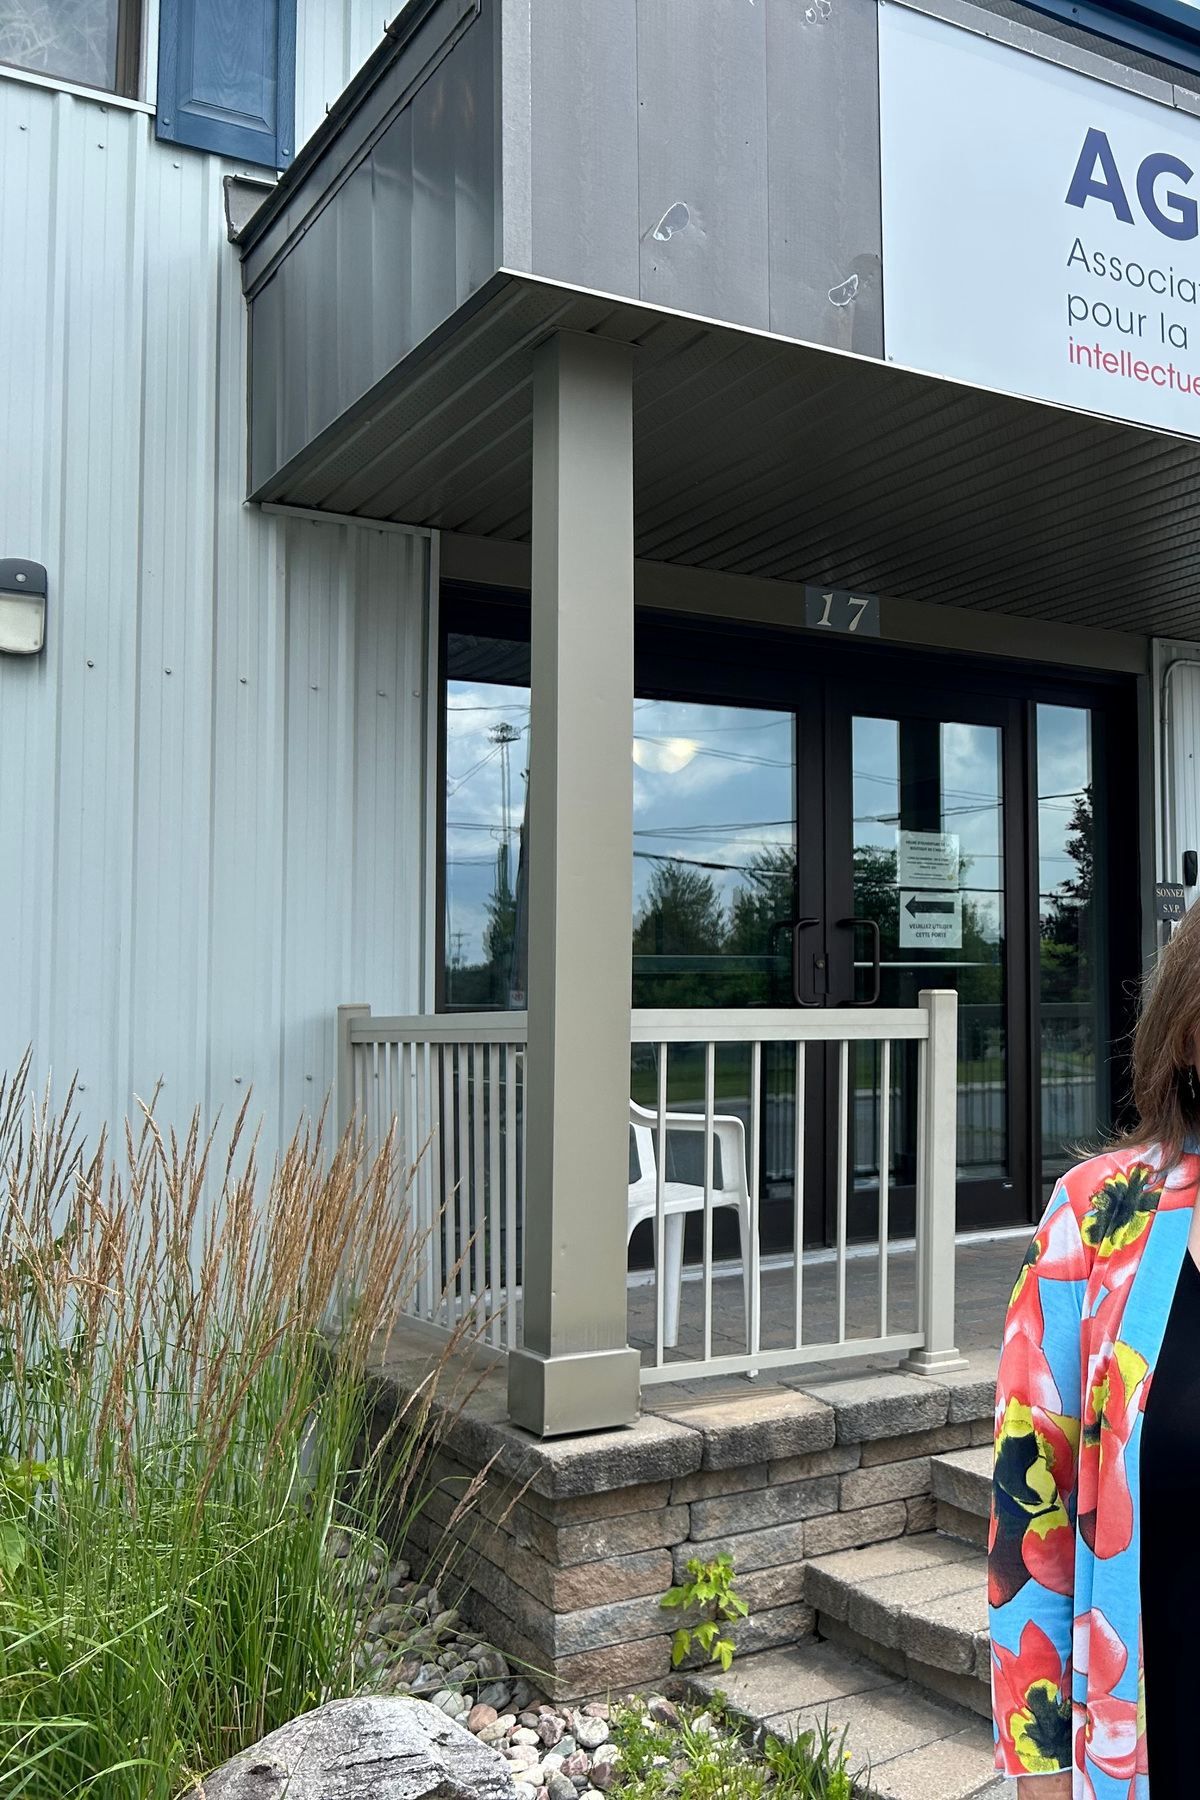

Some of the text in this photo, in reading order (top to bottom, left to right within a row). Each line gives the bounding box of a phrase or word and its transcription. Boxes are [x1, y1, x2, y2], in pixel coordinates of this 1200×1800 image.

[1067, 293, 1147, 337] pour
[1160, 312, 1188, 350] la
[816, 592, 870, 632] 17
[1156, 888, 1184, 897] SONNEZ
[1162, 904, 1181, 913] S.V.P.
[931, 931, 947, 939] PORTE
